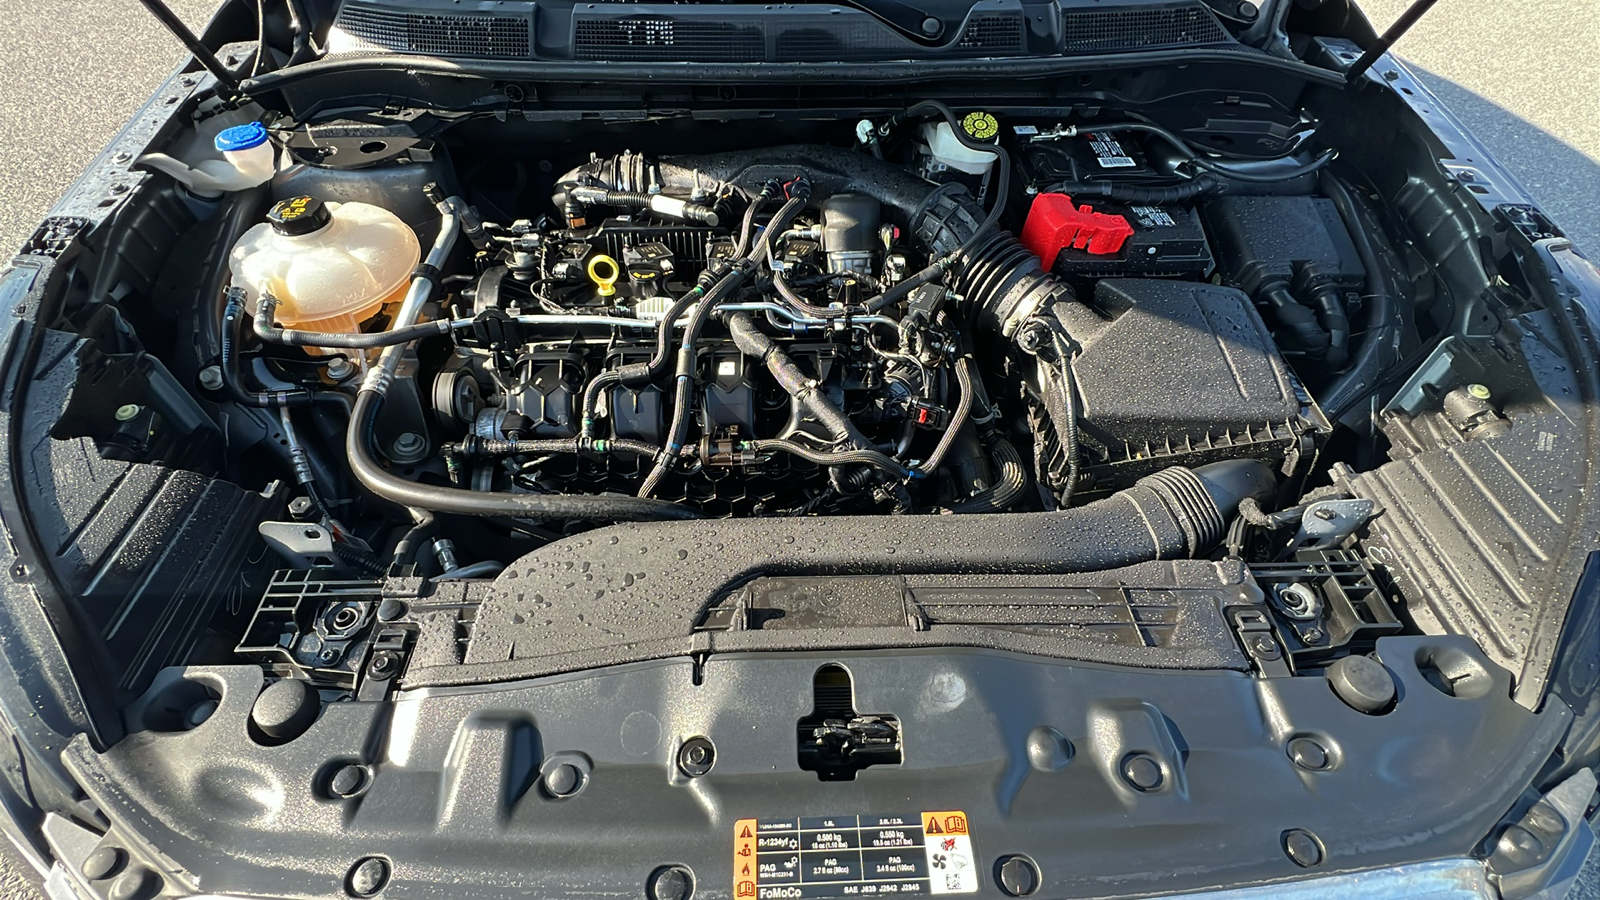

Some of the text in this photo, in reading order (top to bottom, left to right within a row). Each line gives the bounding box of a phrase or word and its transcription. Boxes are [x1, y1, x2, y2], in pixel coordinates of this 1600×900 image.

[833, 832, 842, 843] kg
[896, 830, 904, 839] kg
[758, 837, 789, 847] R-1234yf
[824, 858, 838, 866] PAG
[888, 856, 902, 864] PAG
[760, 864, 776, 873] PAG
[760, 887, 802, 899] FoMoCo
[843, 885, 858, 894] SAE
